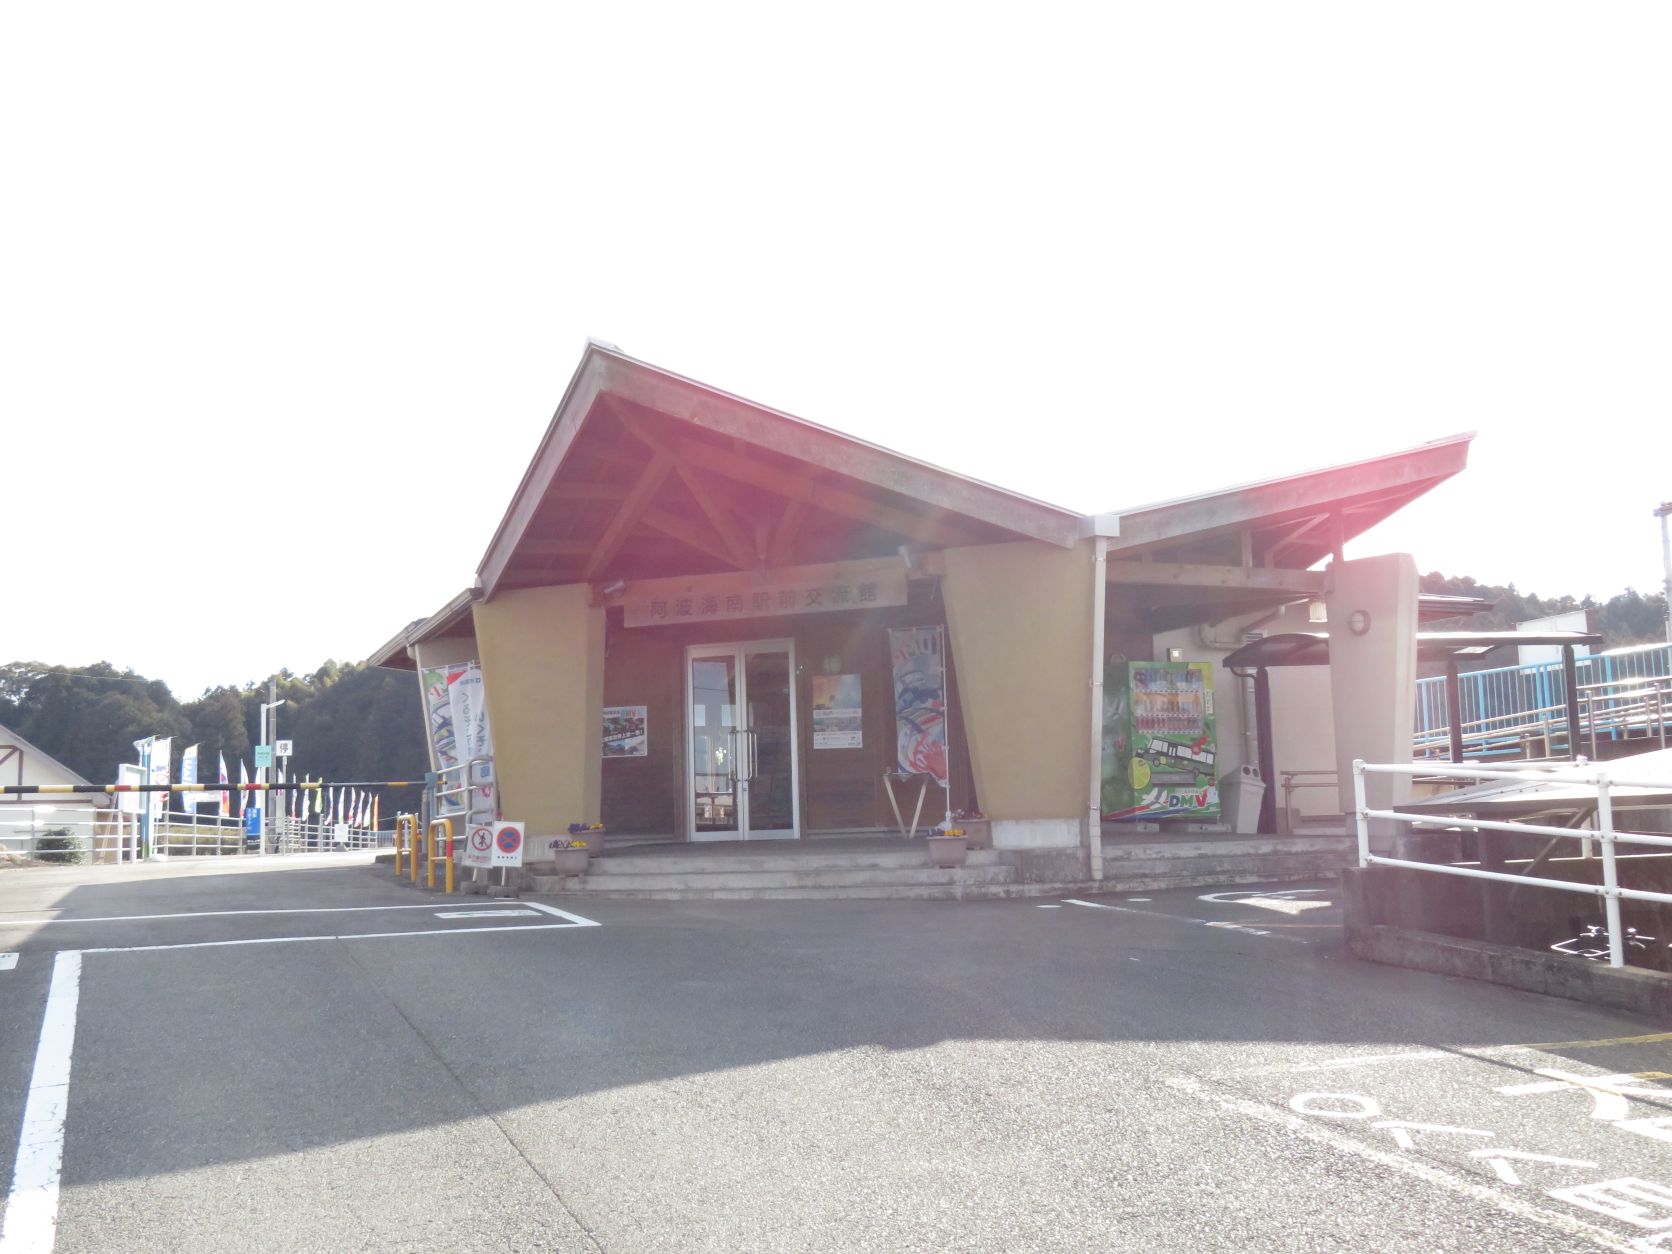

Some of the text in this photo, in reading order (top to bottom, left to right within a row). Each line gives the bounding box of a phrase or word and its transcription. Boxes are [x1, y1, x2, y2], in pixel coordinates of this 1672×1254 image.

[648, 582, 879, 619] 阿波海南駅前交流館
[1169, 787, 1208, 808] DMV
